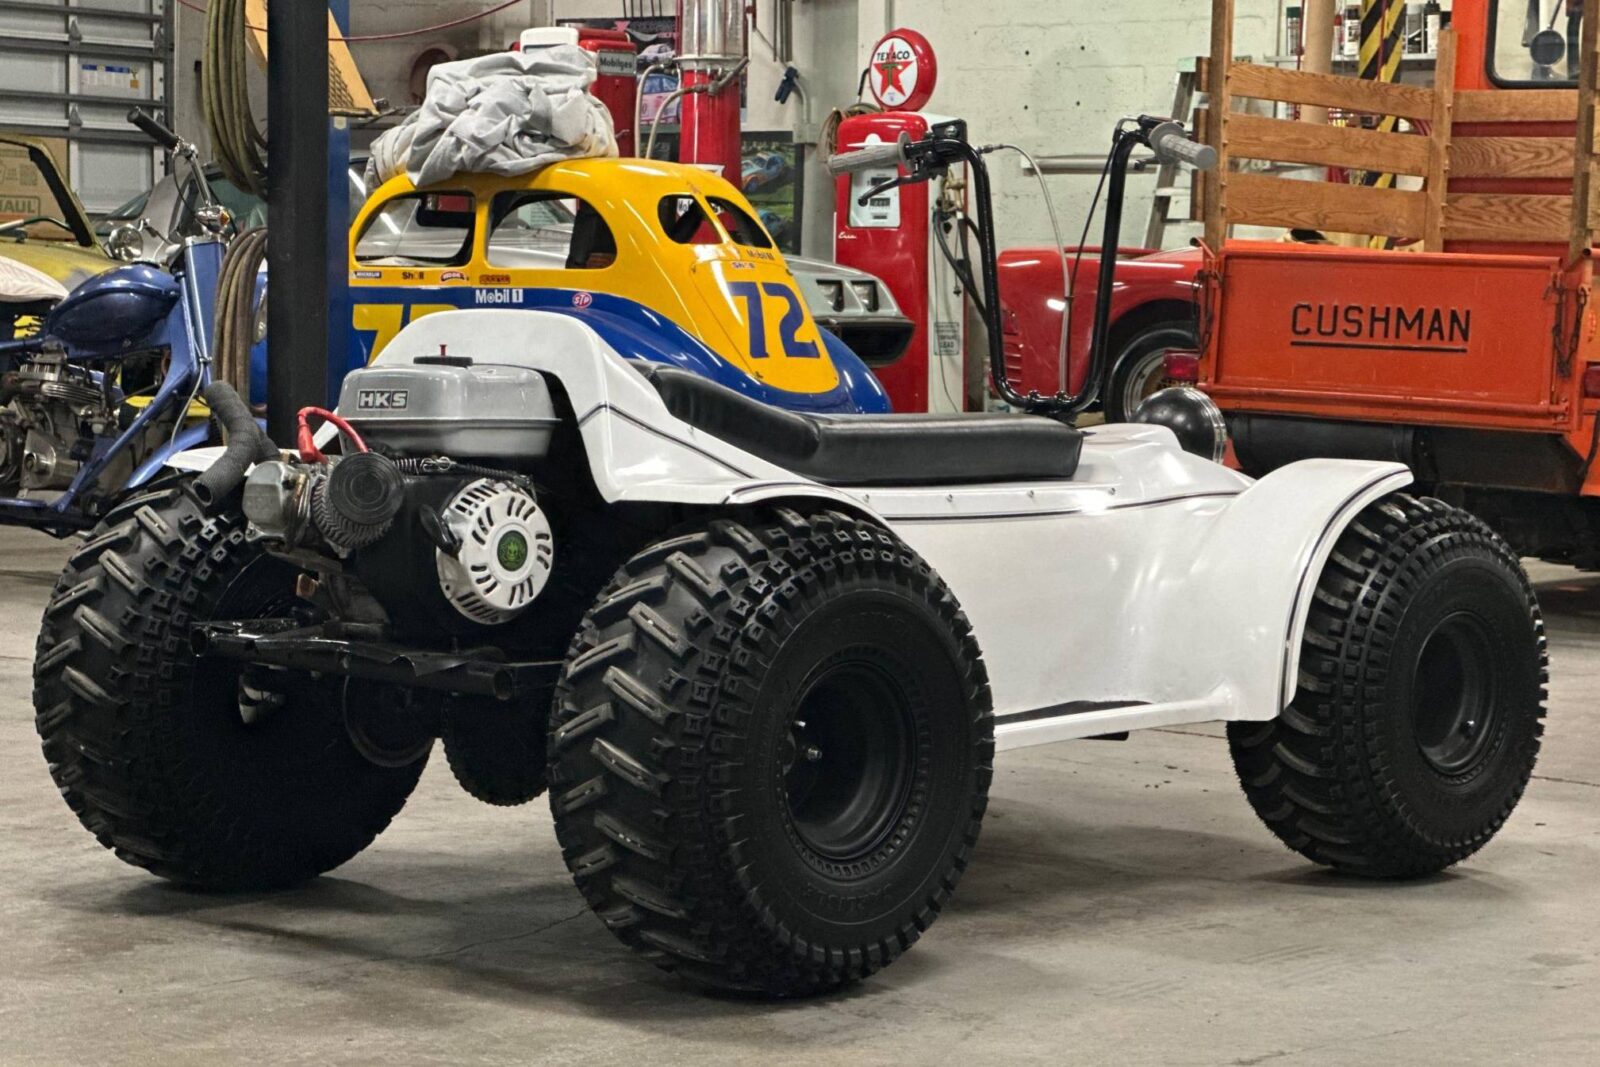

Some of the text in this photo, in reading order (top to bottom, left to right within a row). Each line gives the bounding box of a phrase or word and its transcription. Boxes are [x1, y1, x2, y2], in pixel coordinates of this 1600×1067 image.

[877, 50, 910, 61] TEXACO
[475, 288, 509, 304] Mobil
[573, 293, 591, 306] STP
[726, 281, 820, 358] 72
[1291, 303, 1471, 342] CUSHMAN
[358, 390, 408, 409] HKS
